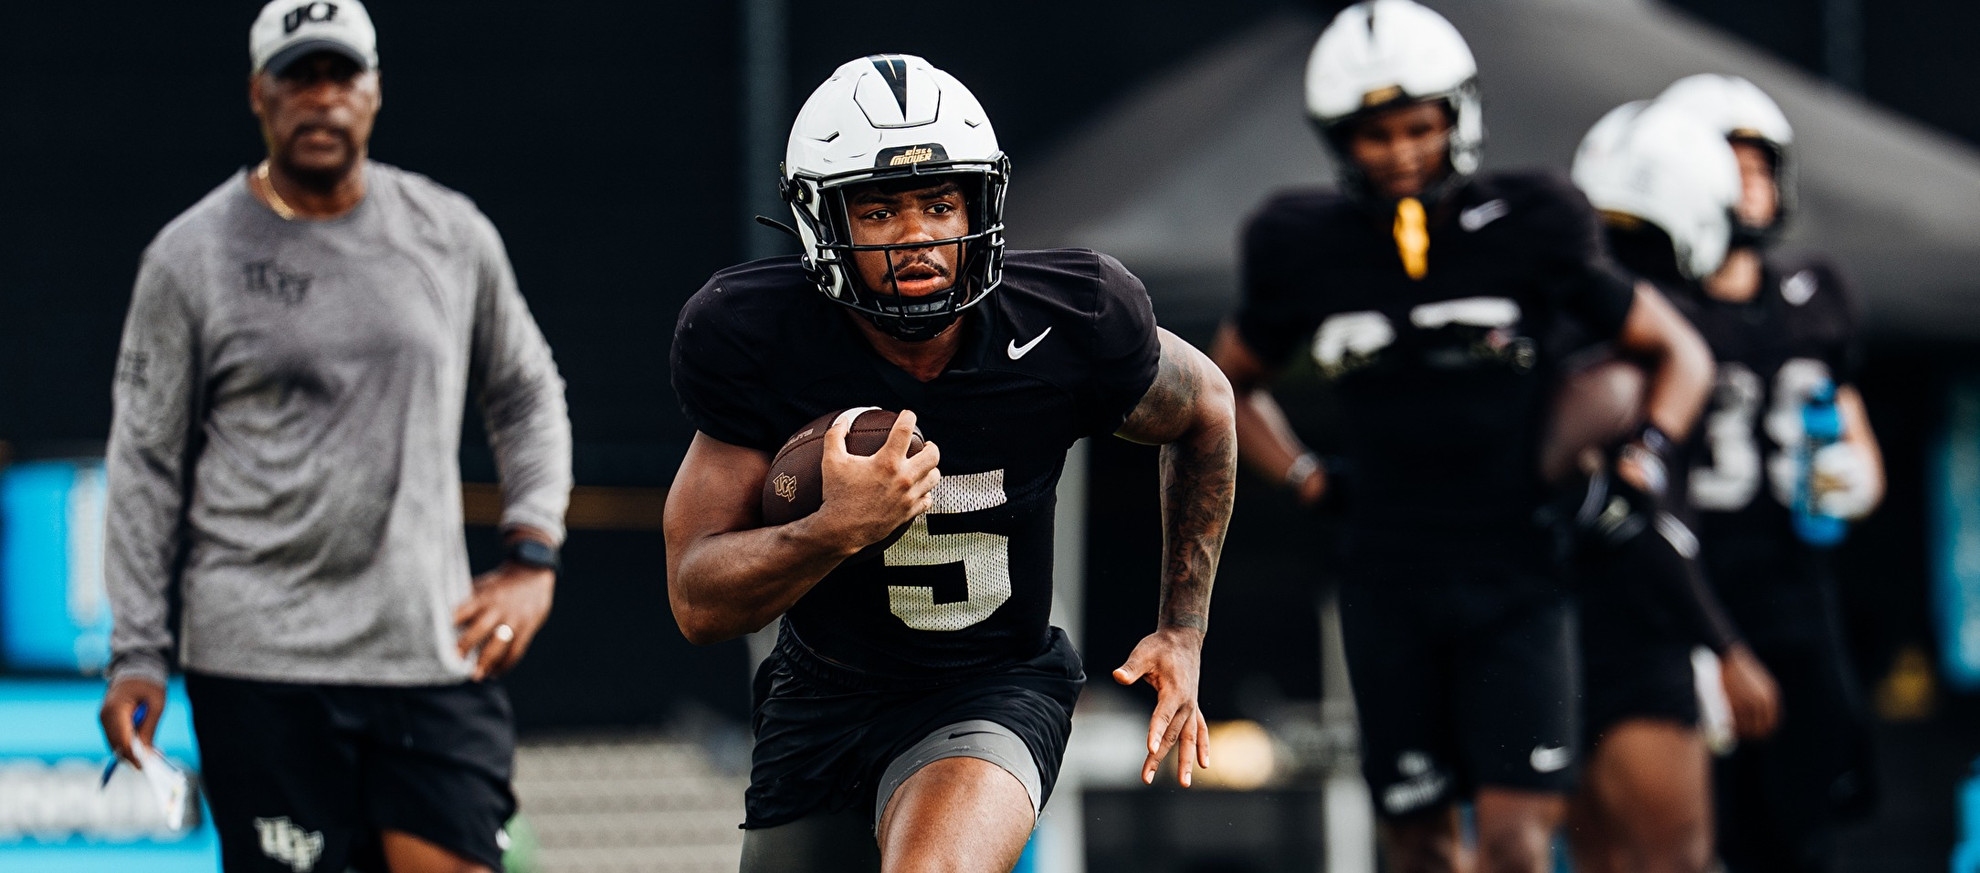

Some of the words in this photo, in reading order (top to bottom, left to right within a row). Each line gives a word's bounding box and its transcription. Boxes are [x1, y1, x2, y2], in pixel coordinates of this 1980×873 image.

[284, 2, 338, 33] UCF
[773, 472, 797, 502] UCF
[883, 468, 1012, 631] 5
